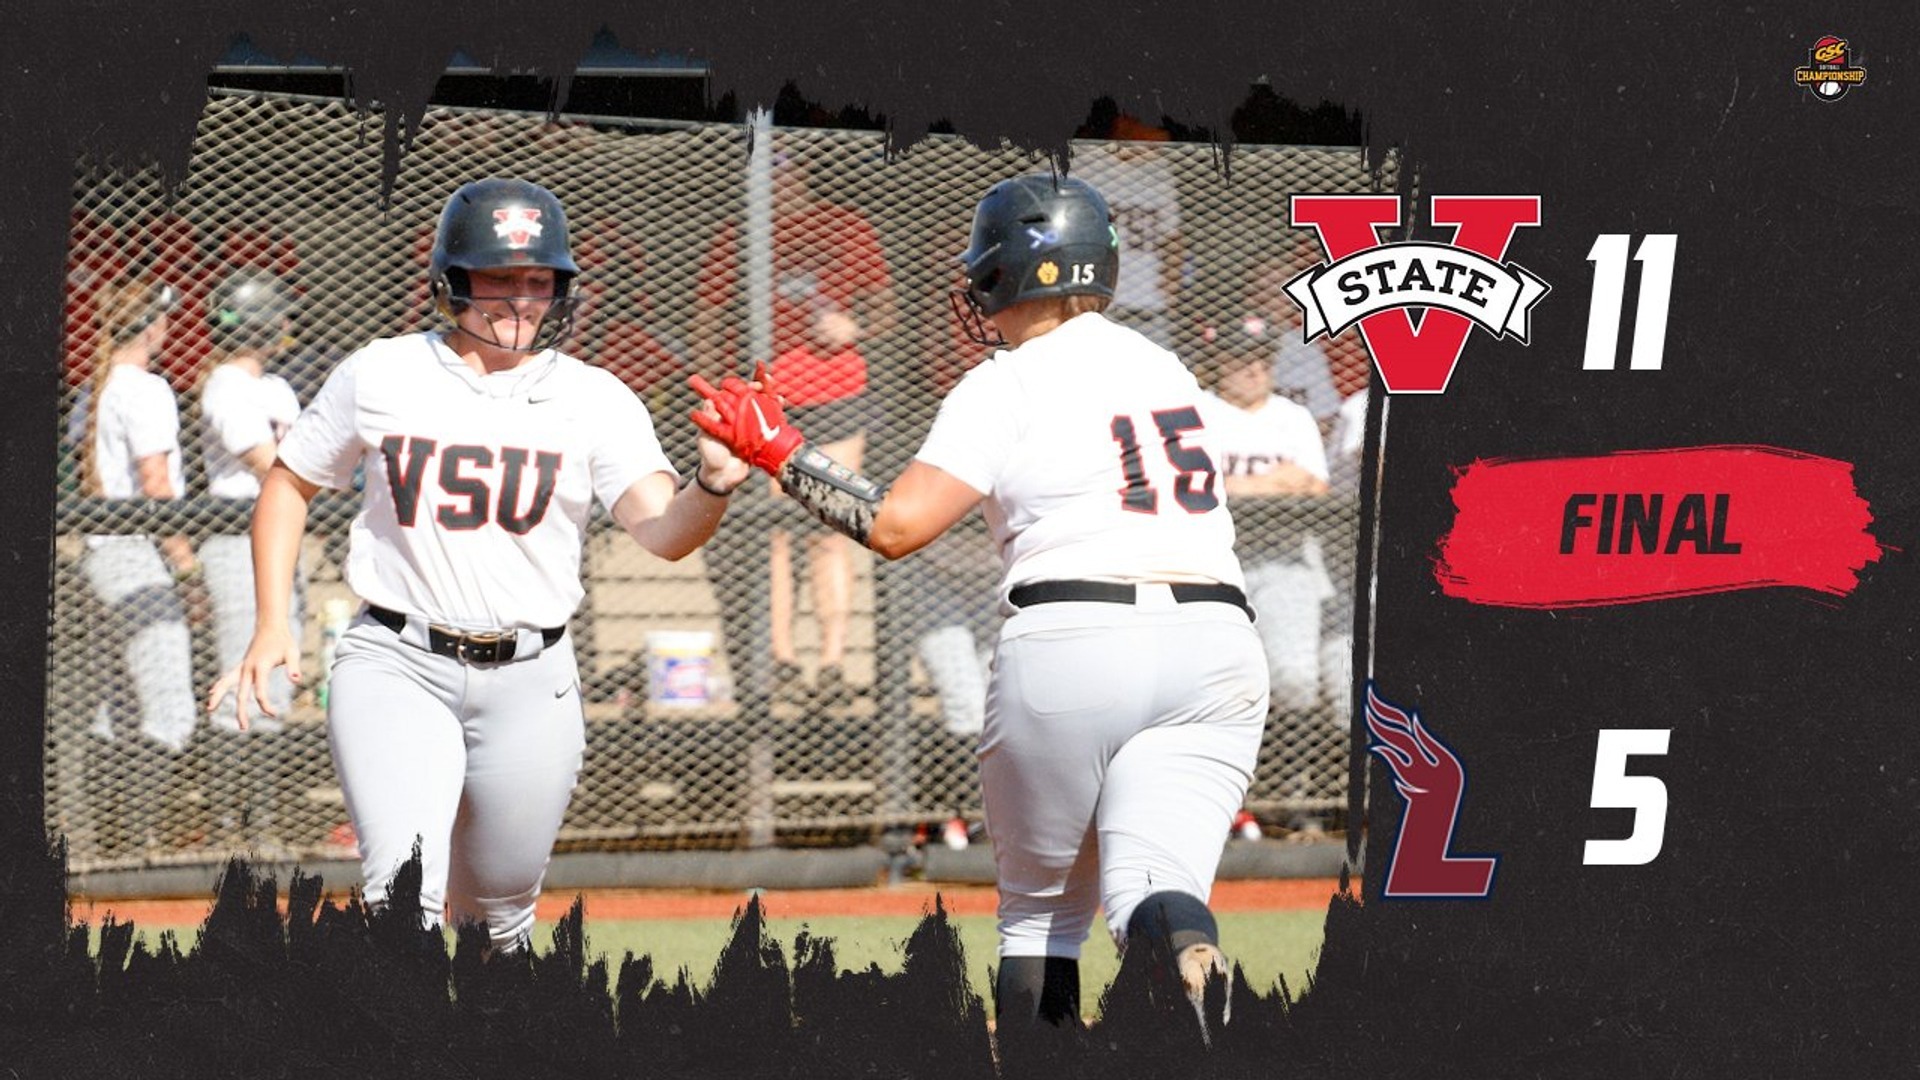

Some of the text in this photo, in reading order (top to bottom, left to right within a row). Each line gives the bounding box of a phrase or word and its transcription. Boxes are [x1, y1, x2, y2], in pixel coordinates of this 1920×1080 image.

[1071, 263, 1095, 285] 15
[380, 435, 563, 535] VSU
[1110, 405, 1219, 515] 15
